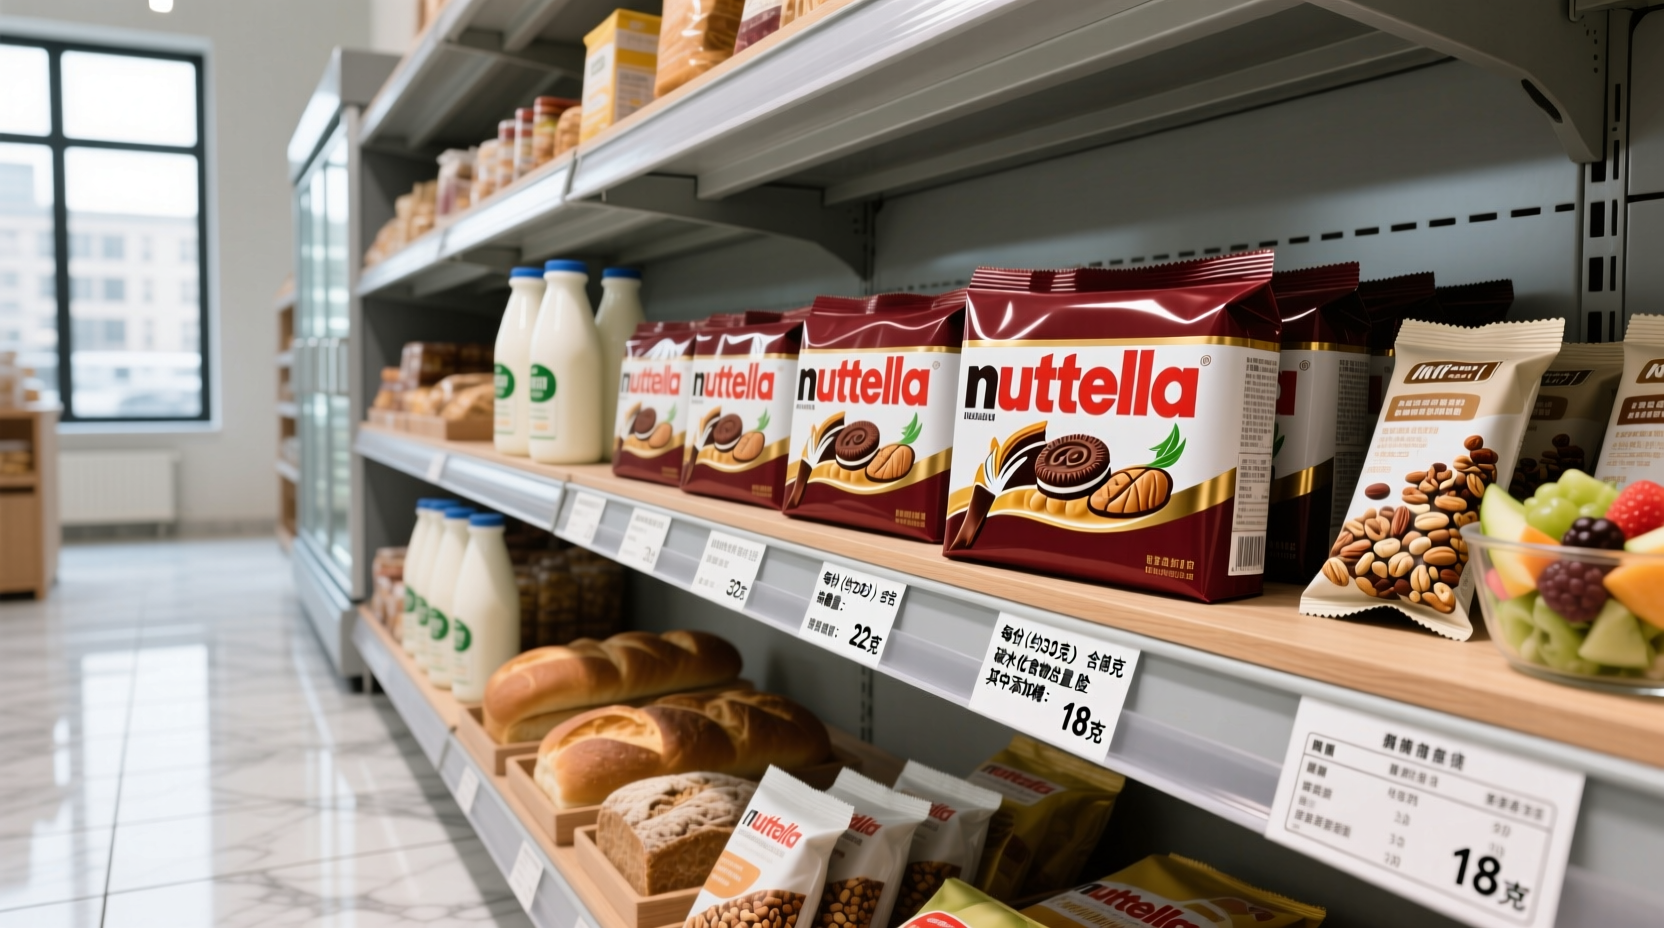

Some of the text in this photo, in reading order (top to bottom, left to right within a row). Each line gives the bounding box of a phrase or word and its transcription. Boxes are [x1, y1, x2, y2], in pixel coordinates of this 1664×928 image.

[620, 365, 681, 395] nuttella
[693, 363, 775, 400] nuttella
[797, 356, 930, 406] nuttella
[965, 350, 1199, 418] nuttella
[849, 624, 883, 655] 22克
[1062, 702, 1106, 744] 18克
[1453, 848, 1530, 911] 18克
